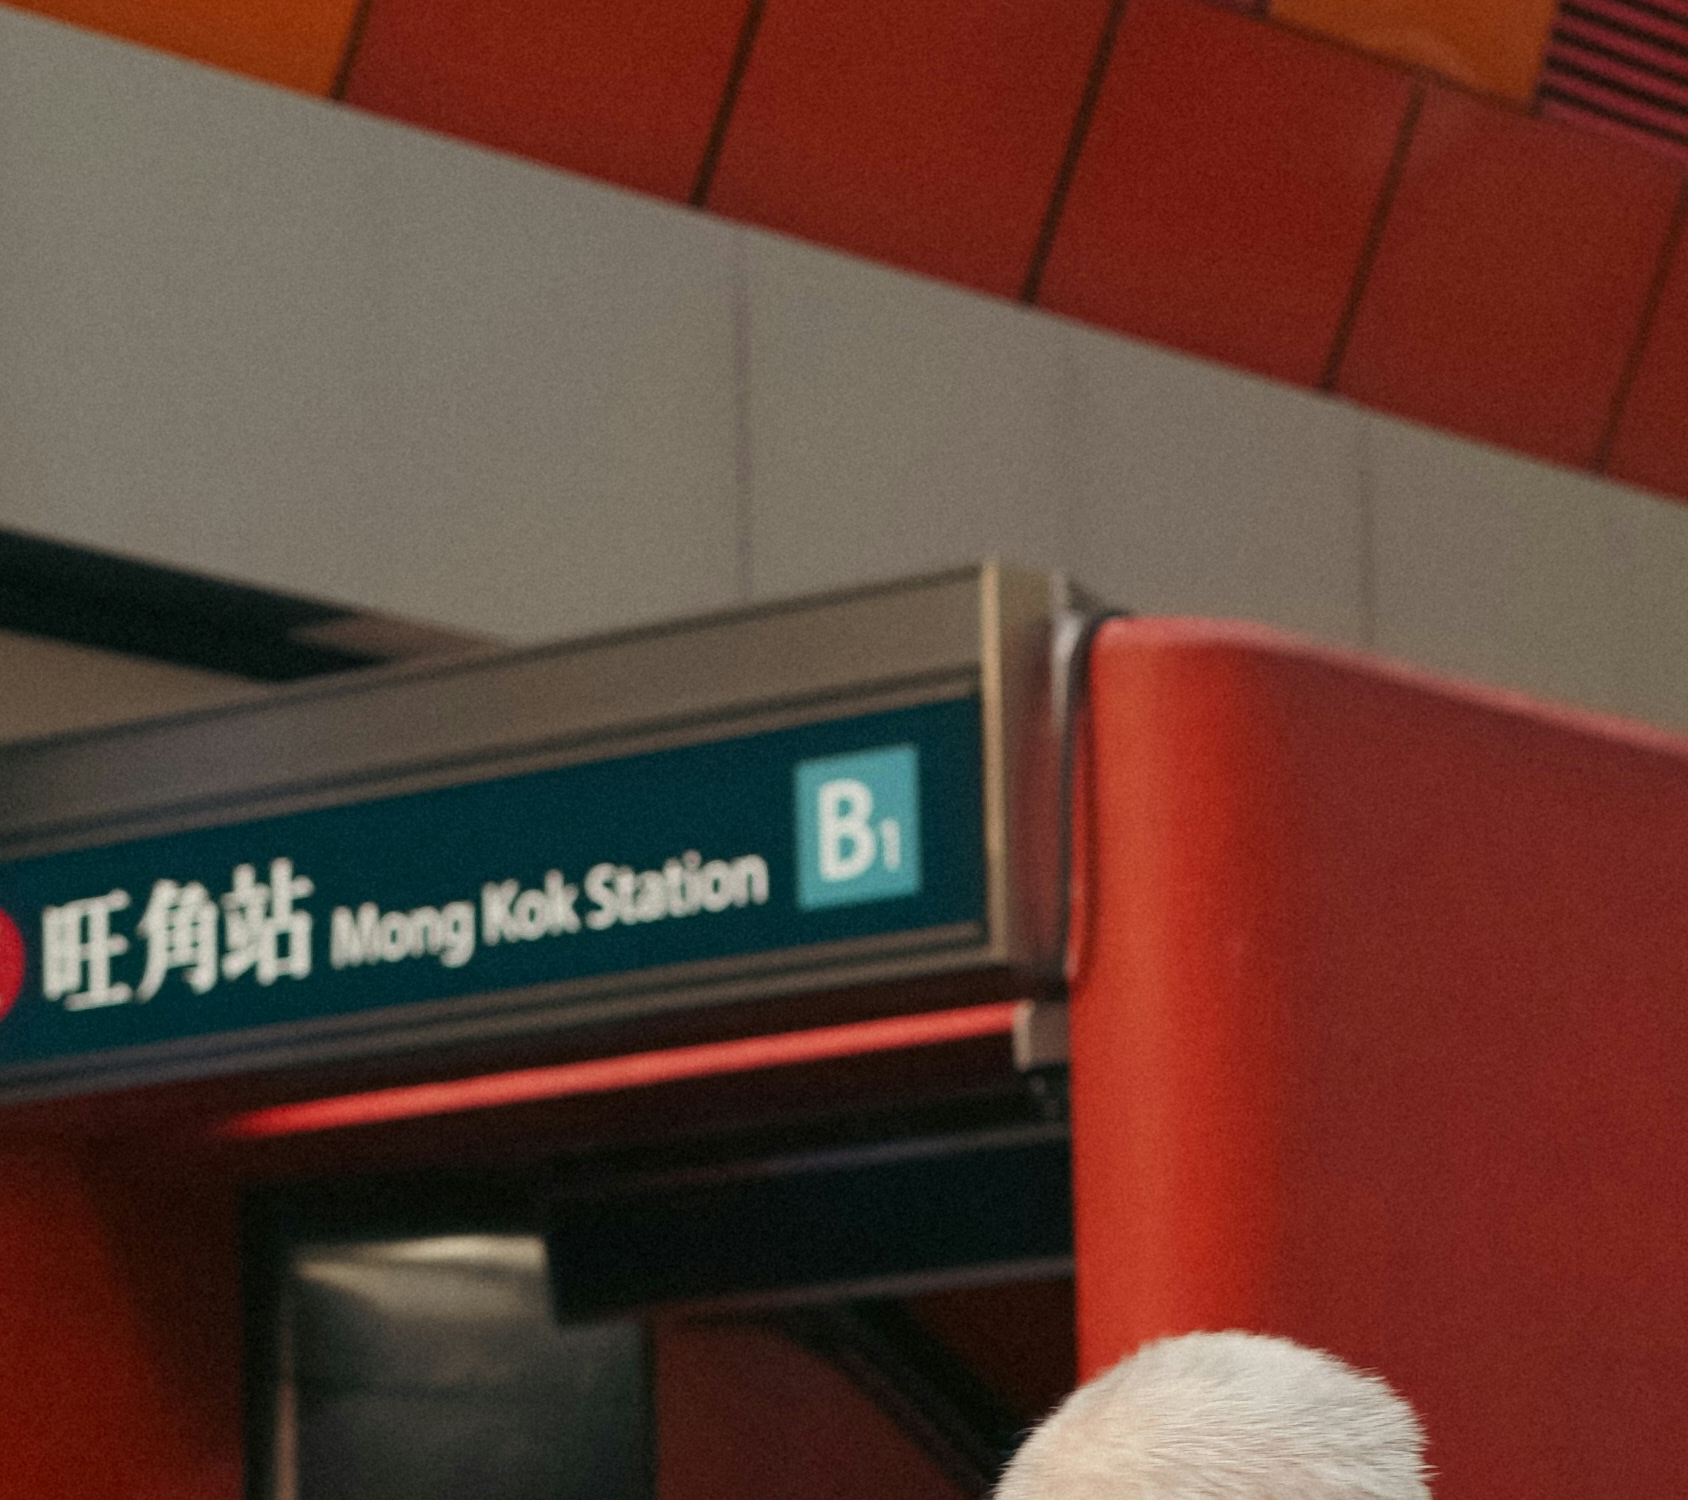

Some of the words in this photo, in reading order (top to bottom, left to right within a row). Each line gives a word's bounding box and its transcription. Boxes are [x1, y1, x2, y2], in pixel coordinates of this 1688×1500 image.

[817, 777, 902, 884] B1
[41, 855, 315, 1012] 旺角站
[330, 900, 476, 970] Mong
[480, 867, 582, 946] Kok
[583, 848, 770, 931] Station
